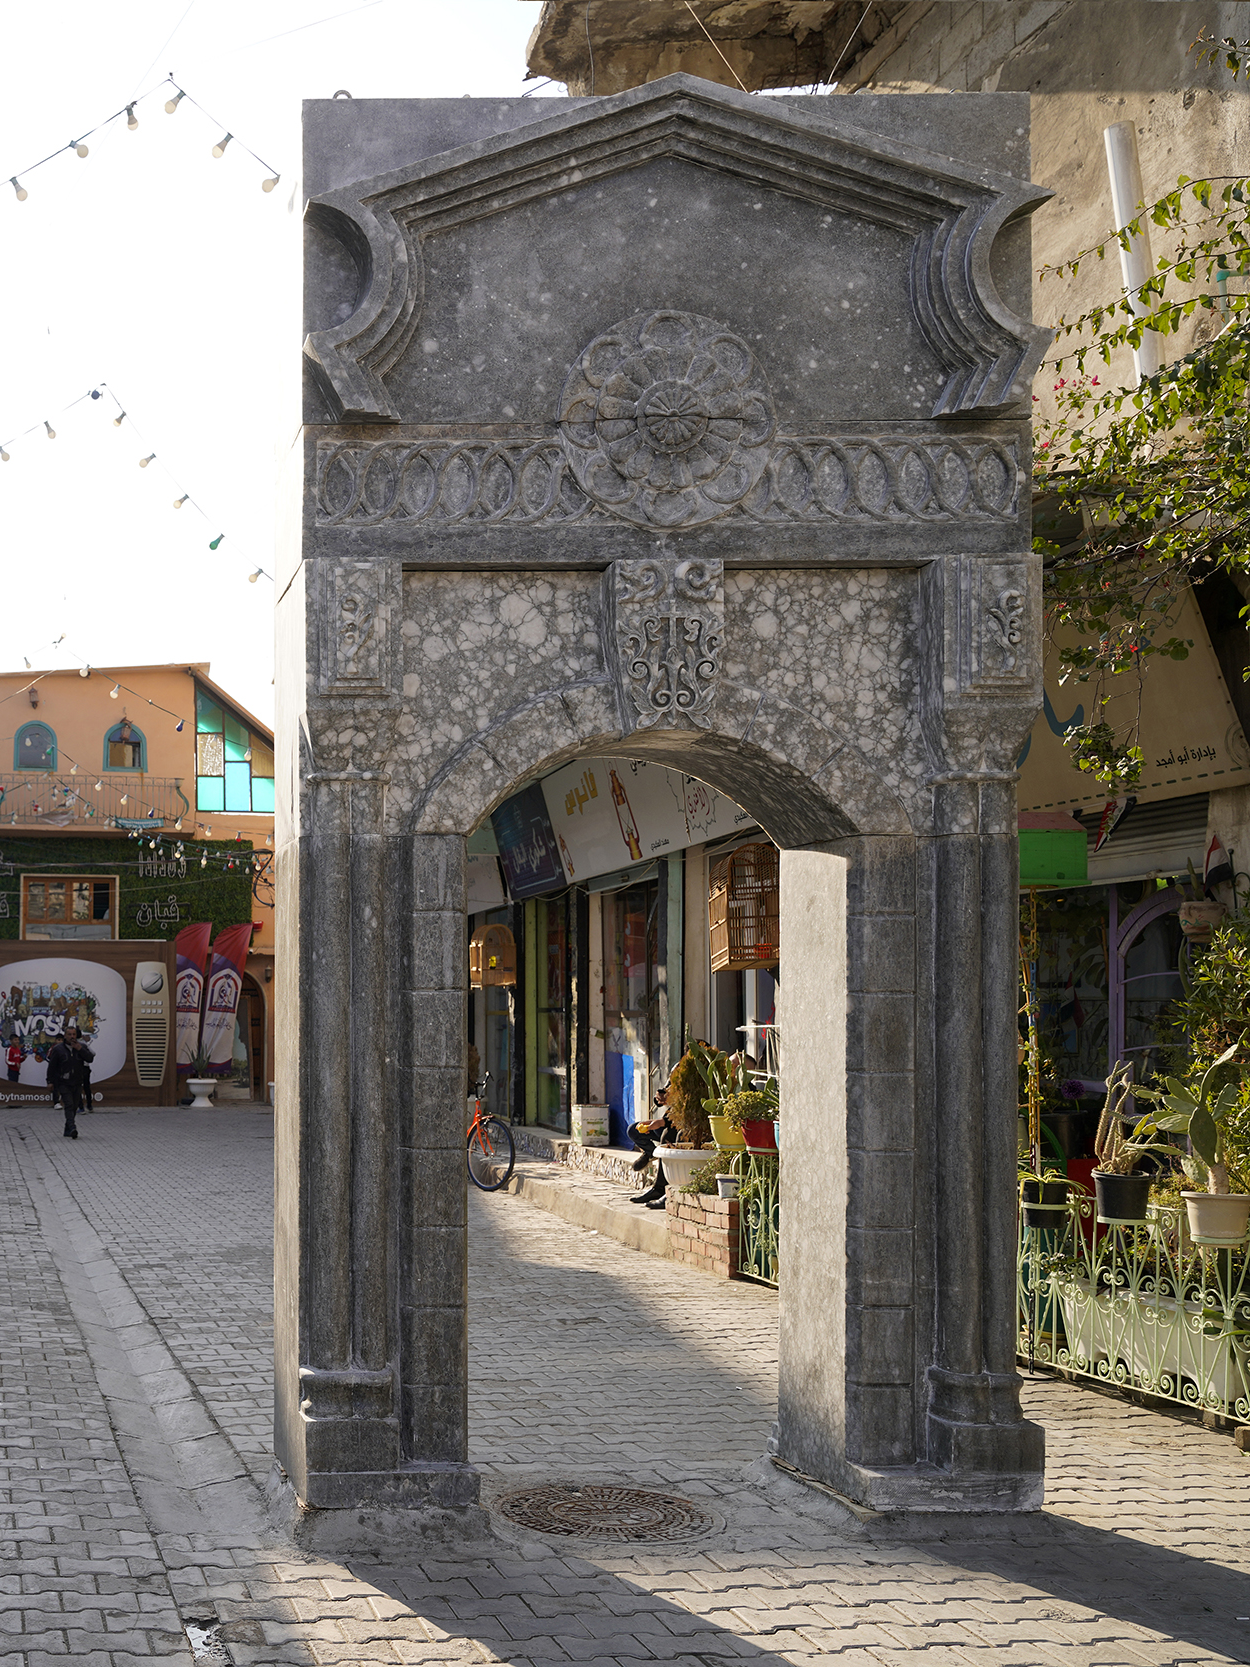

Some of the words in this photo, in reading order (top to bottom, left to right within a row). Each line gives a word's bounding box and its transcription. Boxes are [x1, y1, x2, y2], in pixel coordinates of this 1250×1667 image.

[1155, 749, 1176, 768] أمجد
[1177, 746, 1190, 765] أبو
[1190, 745, 1217, 761] بإدارة
[564, 767, 598, 816] فانوس
